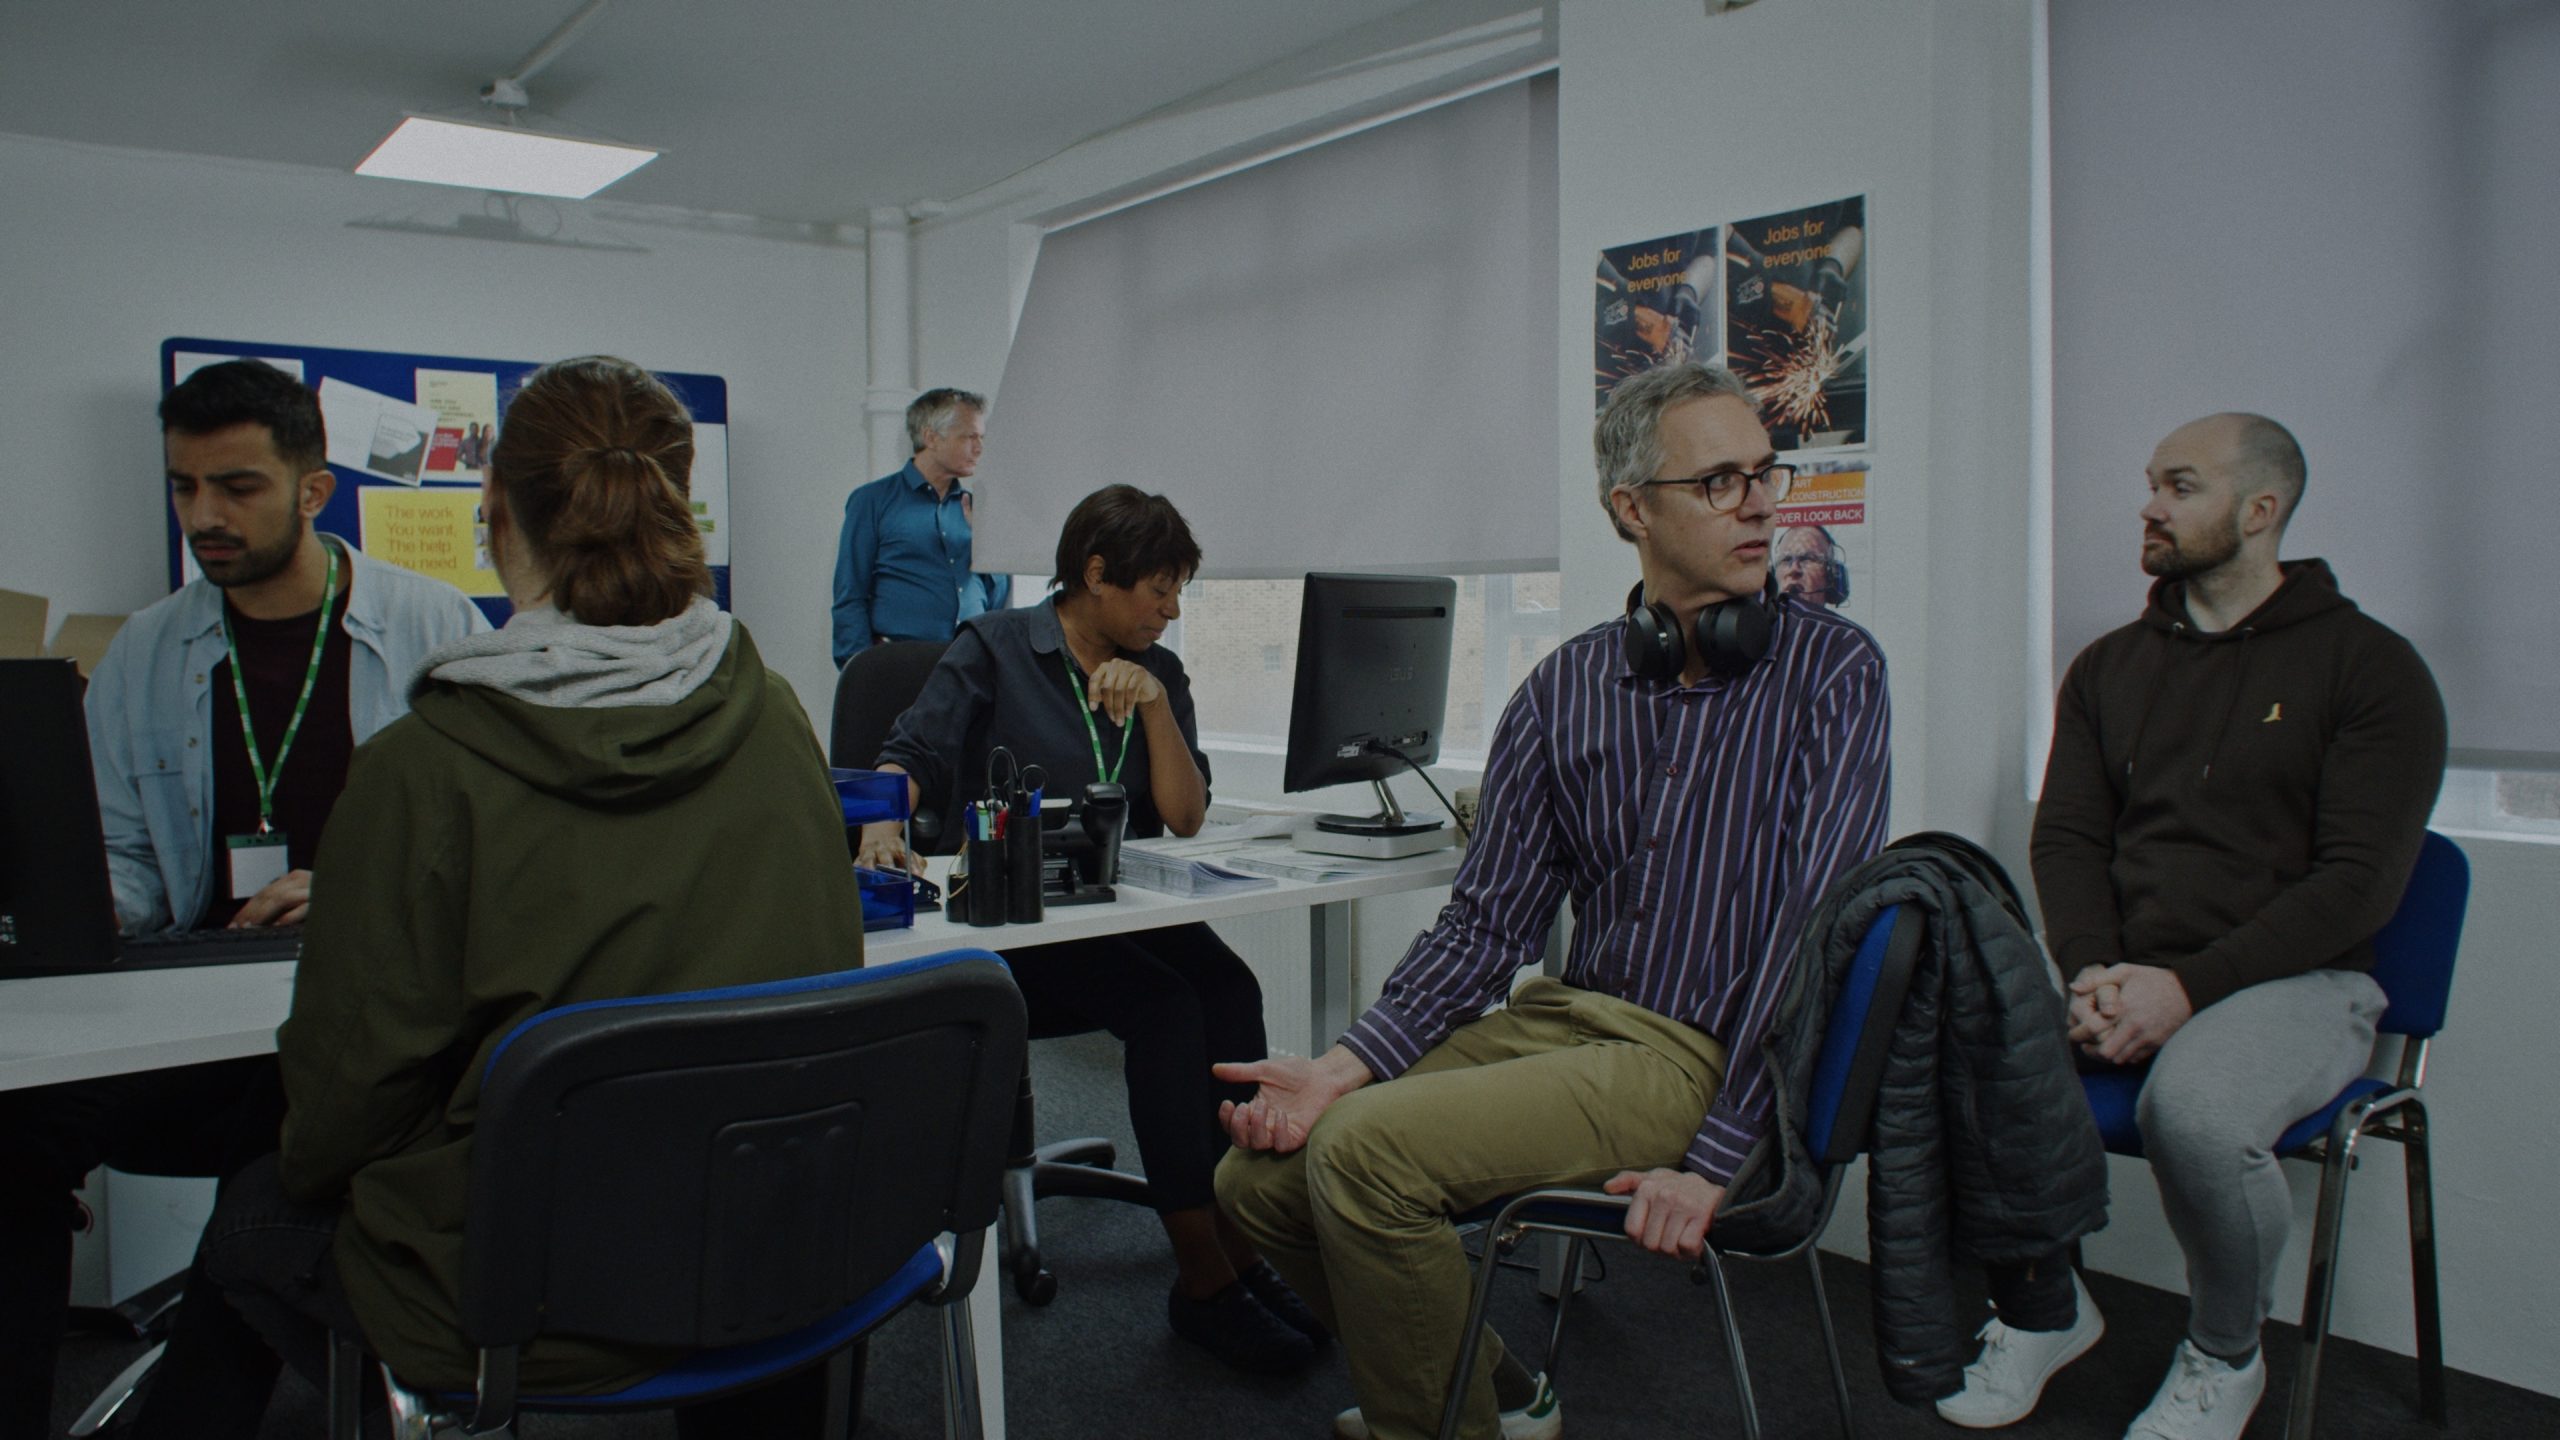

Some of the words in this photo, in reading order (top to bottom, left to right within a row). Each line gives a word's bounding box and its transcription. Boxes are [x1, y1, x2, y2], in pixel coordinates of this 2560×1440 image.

[1763, 225, 1799, 246] Jobs
[1803, 220, 1825, 238] for
[1628, 252, 1659, 271] Jobs
[1663, 248, 1681, 263] for
[1763, 243, 1832, 269] everyone
[1627, 271, 1687, 293] everyone
[1791, 489, 1863, 501] CONSTRUCTION
[384, 504, 414, 518] The
[418, 506, 454, 519] work
[1776, 511, 1801, 523] EVER
[1804, 510, 1831, 523] LOOK
[1834, 508, 1862, 521] BACK
[385, 522, 414, 536] You
[418, 524, 457, 538] want,
[386, 539, 415, 553] The
[420, 539, 452, 554] help
[420, 555, 456, 569] need
